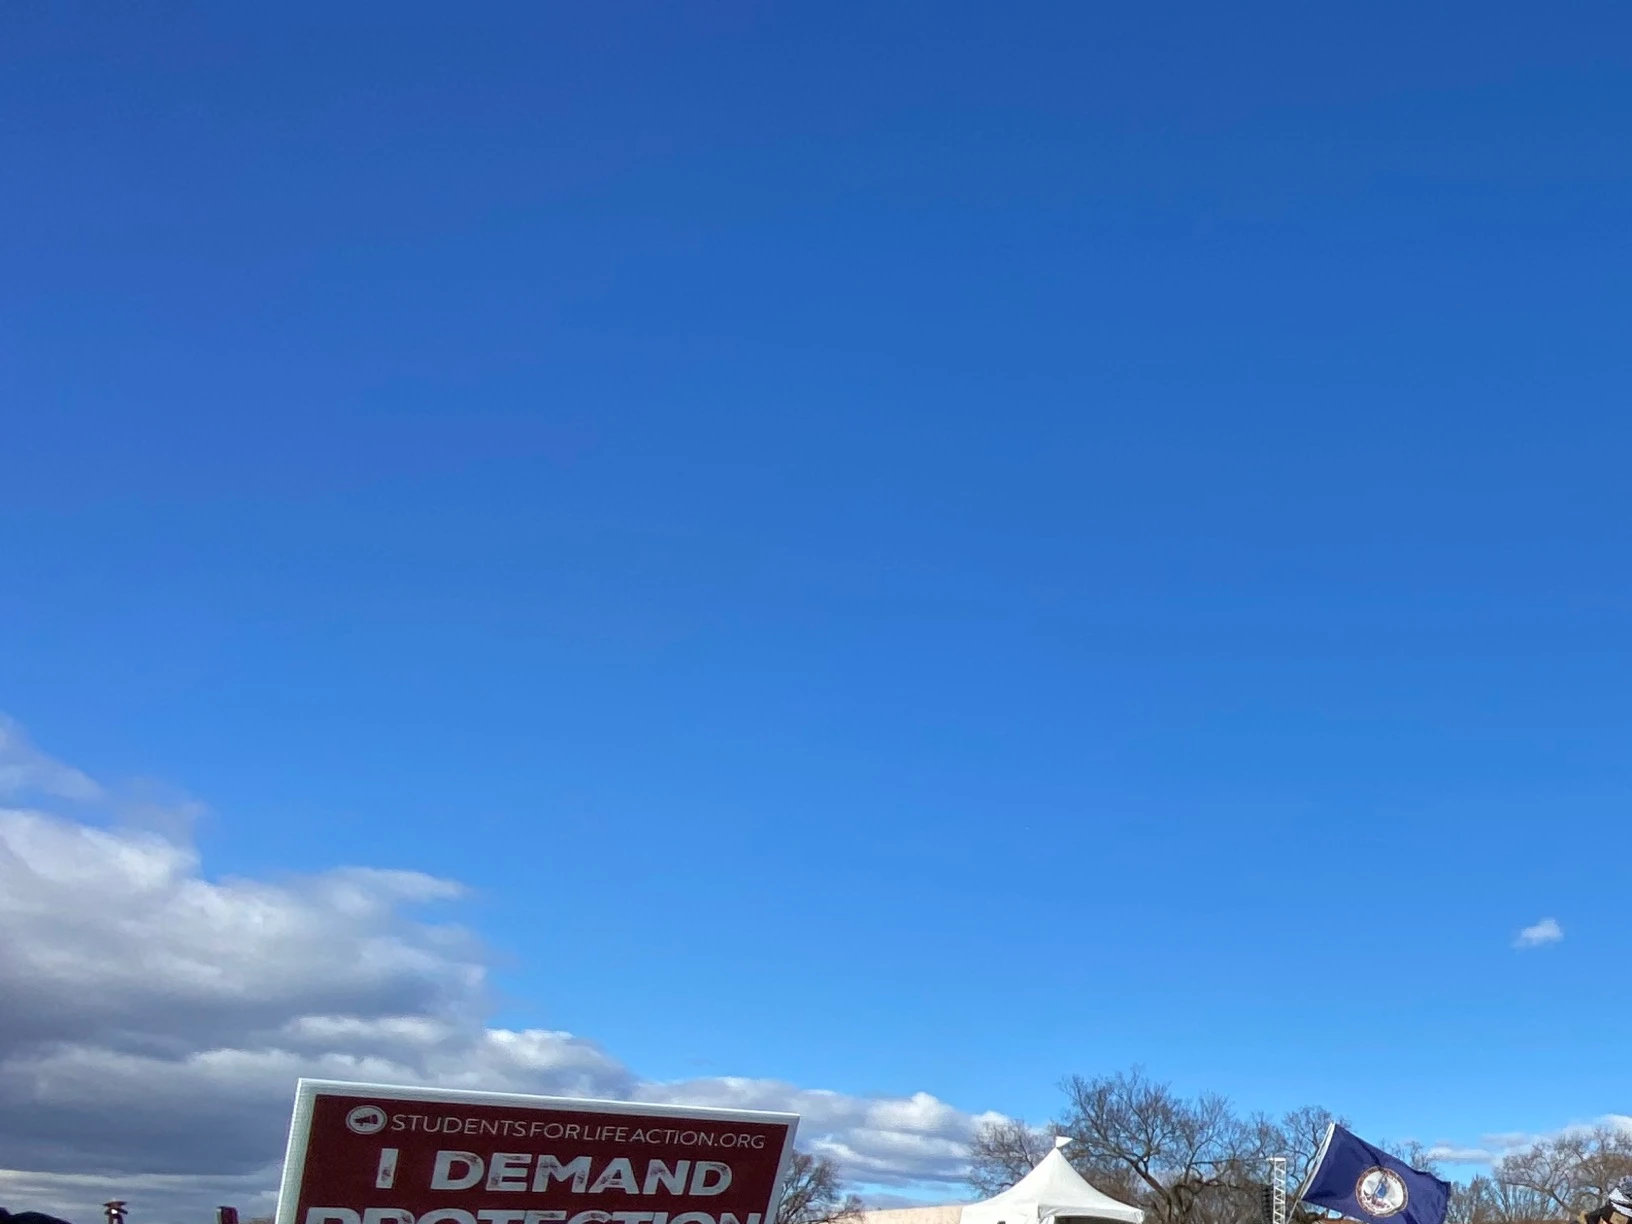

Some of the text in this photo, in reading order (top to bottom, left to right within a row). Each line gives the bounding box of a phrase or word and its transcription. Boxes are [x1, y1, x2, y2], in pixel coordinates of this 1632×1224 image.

[390, 1114, 766, 1149] STUDENTSFORLIFEACTION.ORG
[375, 1148, 733, 1196] I DEMAND
